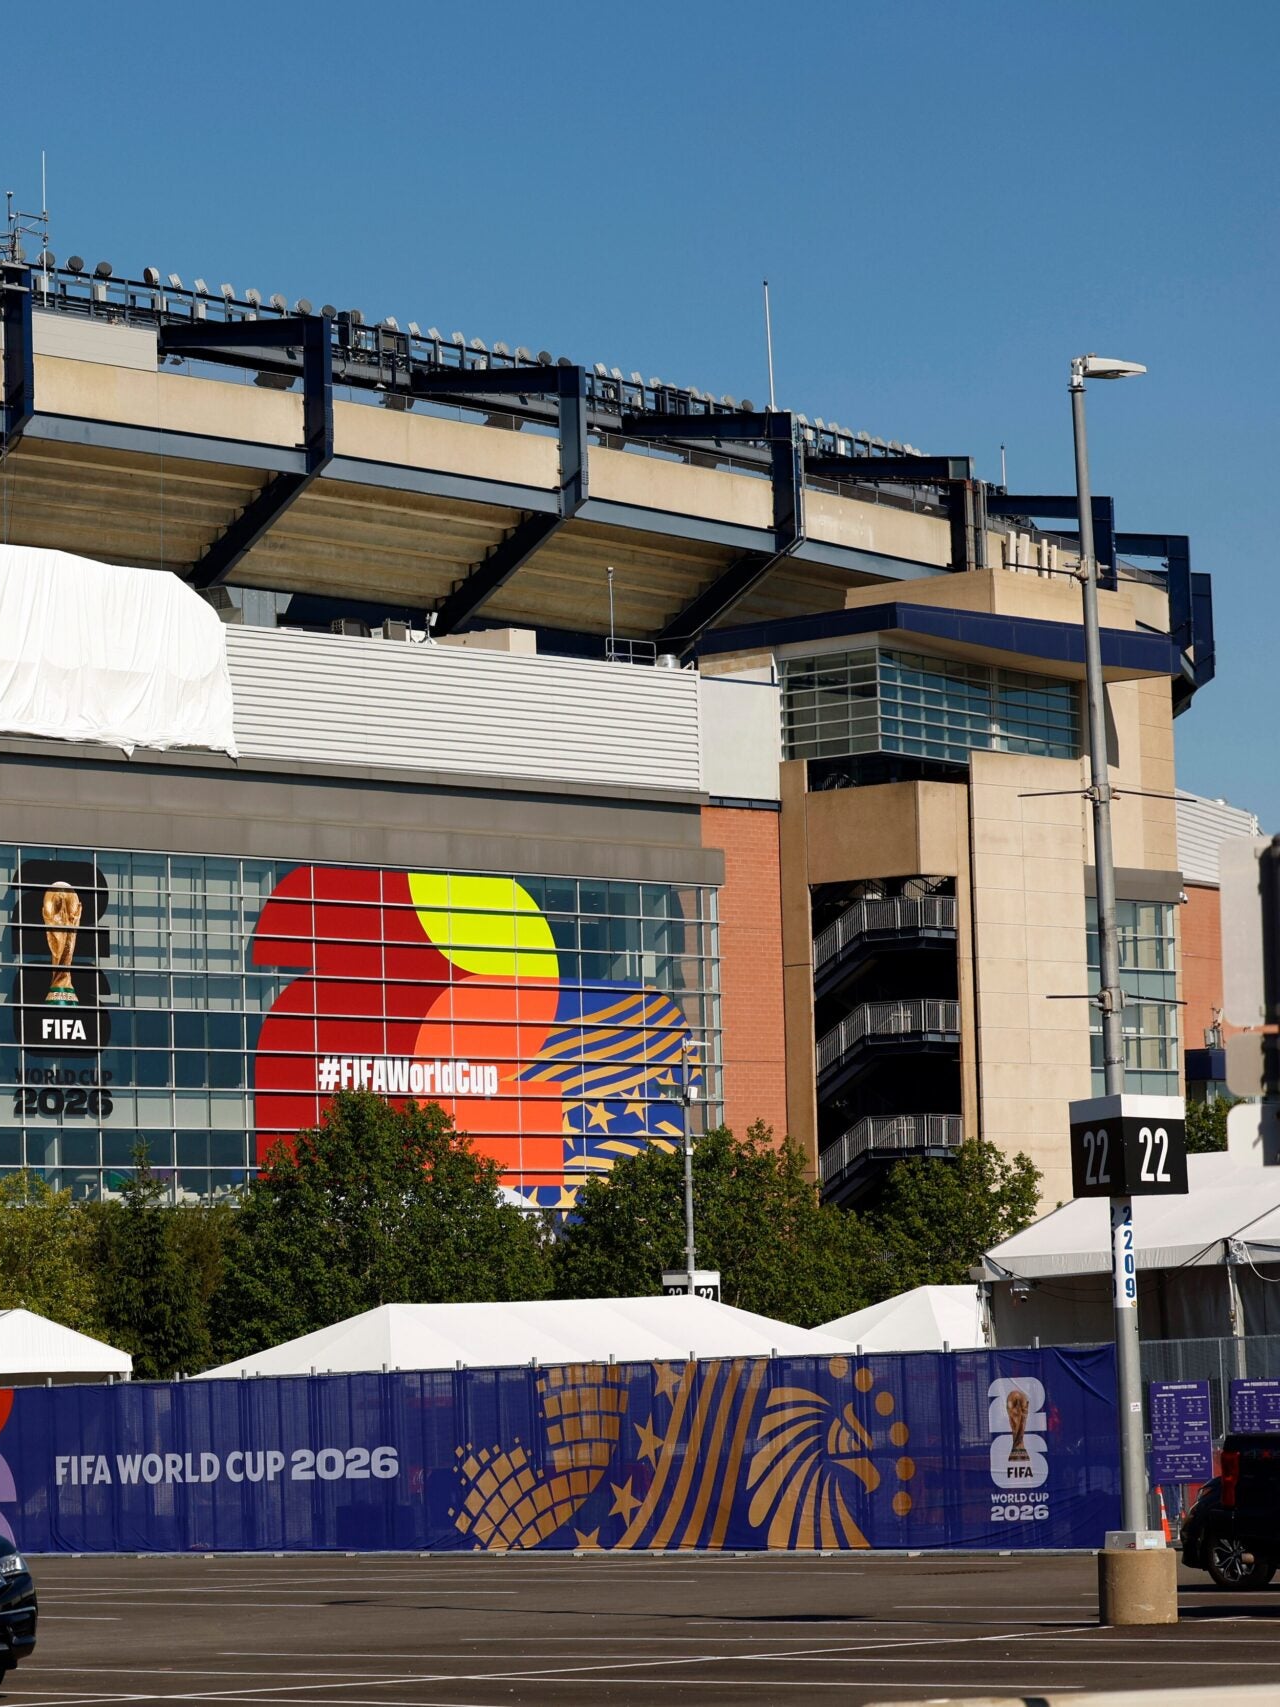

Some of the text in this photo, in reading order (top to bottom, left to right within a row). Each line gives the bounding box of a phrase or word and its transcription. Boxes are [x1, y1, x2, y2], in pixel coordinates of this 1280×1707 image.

[42, 1018, 87, 1040] FIFA
[14, 1067, 113, 1087] WORLD CUP
[318, 1056, 498, 1095] #FIFAWorldCup
[13, 1087, 114, 1117] 2026
[1083, 1128, 1111, 1186] 22
[1138, 1126, 1171, 1182] 22
[1122, 1205, 1137, 1298] 2209
[55, 1446, 399, 1485] FIFA WORLD CUP 2026
[1007, 1466, 1034, 1479] FIFA
[990, 1492, 1050, 1504] WORLD CUP
[990, 1504, 1050, 1522] 2026
